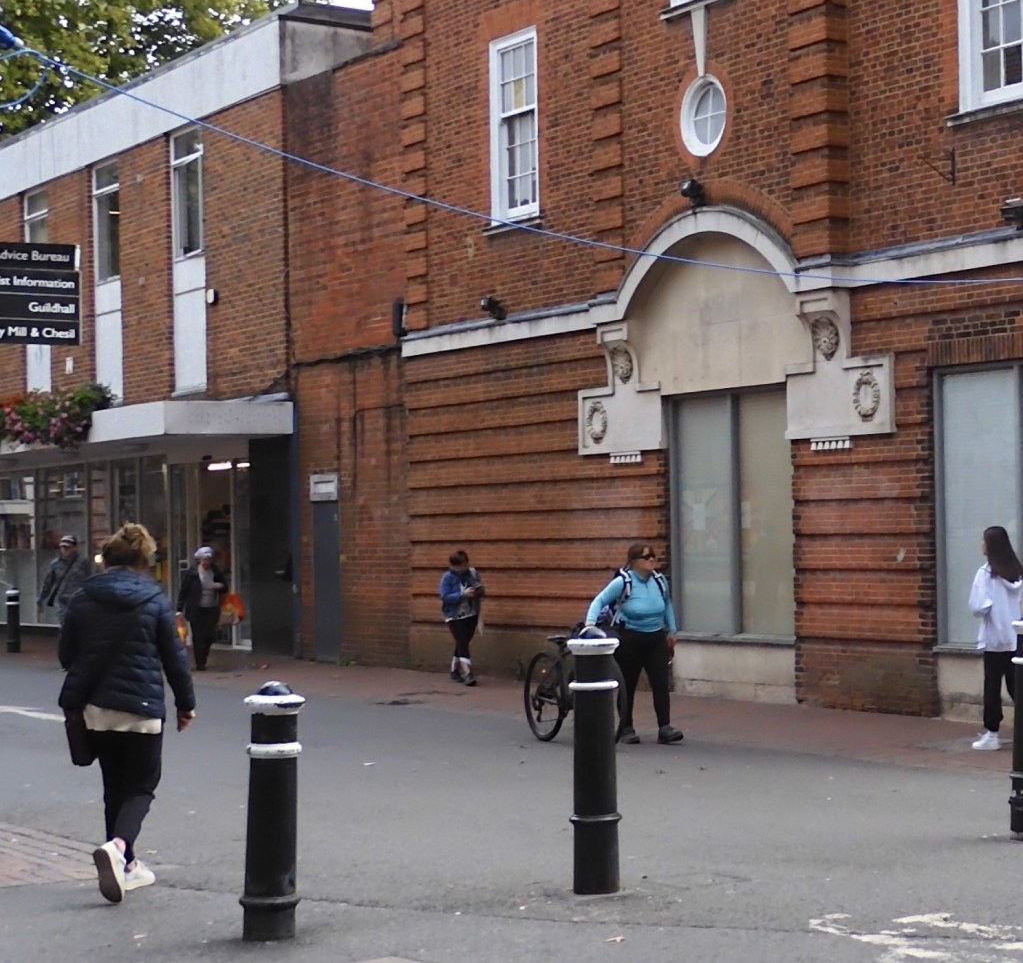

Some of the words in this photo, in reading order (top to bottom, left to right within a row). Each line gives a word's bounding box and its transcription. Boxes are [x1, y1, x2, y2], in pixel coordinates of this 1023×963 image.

[0, 250, 28, 260] dvice
[31, 251, 70, 262] Bureau
[13, 276, 75, 289] Information
[28, 302, 76, 313] Guildhall
[8, 326, 27, 337] Mill
[30, 328, 39, 337] &
[42, 328, 76, 338] Chesil
